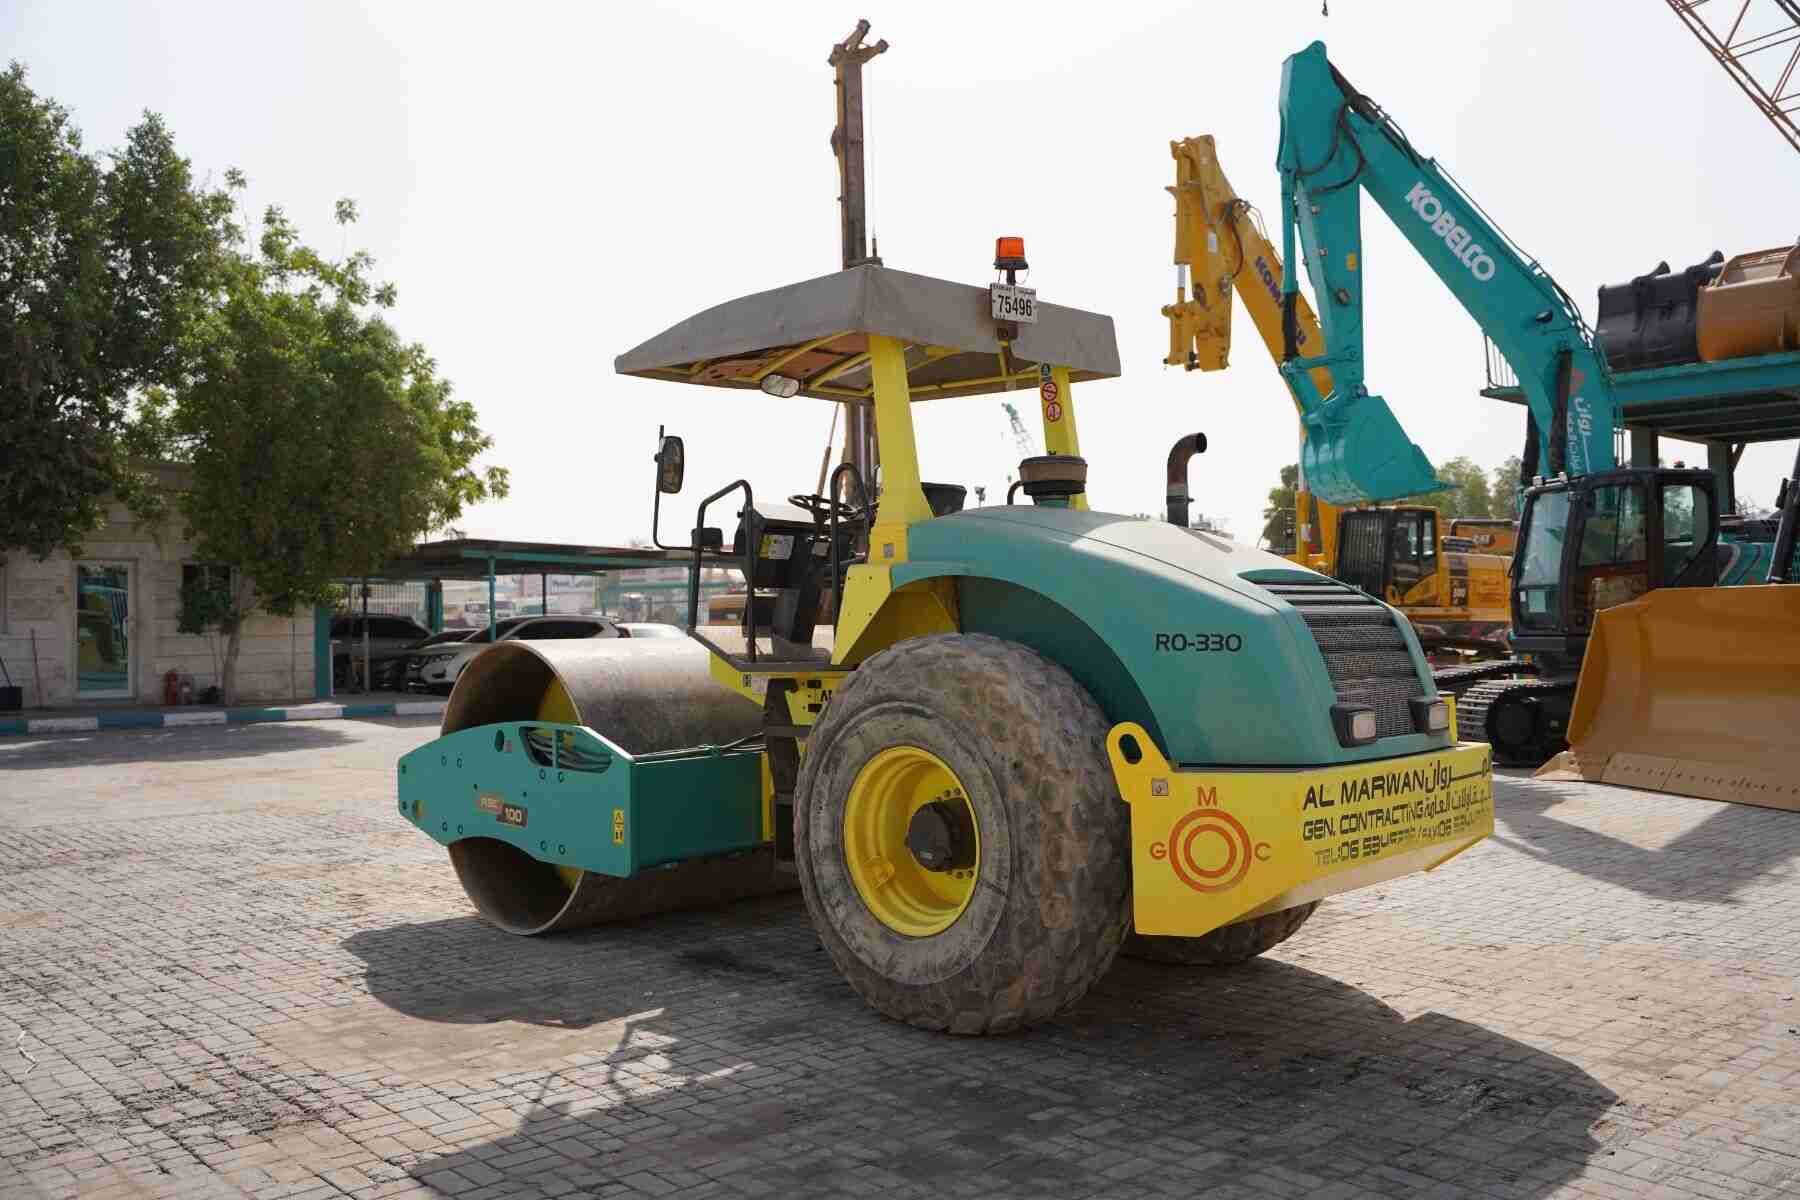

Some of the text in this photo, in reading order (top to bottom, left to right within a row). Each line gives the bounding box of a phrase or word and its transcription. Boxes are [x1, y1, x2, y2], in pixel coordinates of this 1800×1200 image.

[1404, 181, 1496, 281] KOBELCO
[997, 294, 1033, 317] 75496
[1155, 633, 1243, 652] RO-330
[1197, 786, 1218, 807] M
[1303, 768, 1425, 810] AL MARWAN
[1303, 818, 1336, 841] GEN.
[1339, 797, 1424, 835] CONTRACTING
[1151, 842, 1167, 860] G
[1255, 842, 1271, 861] C
